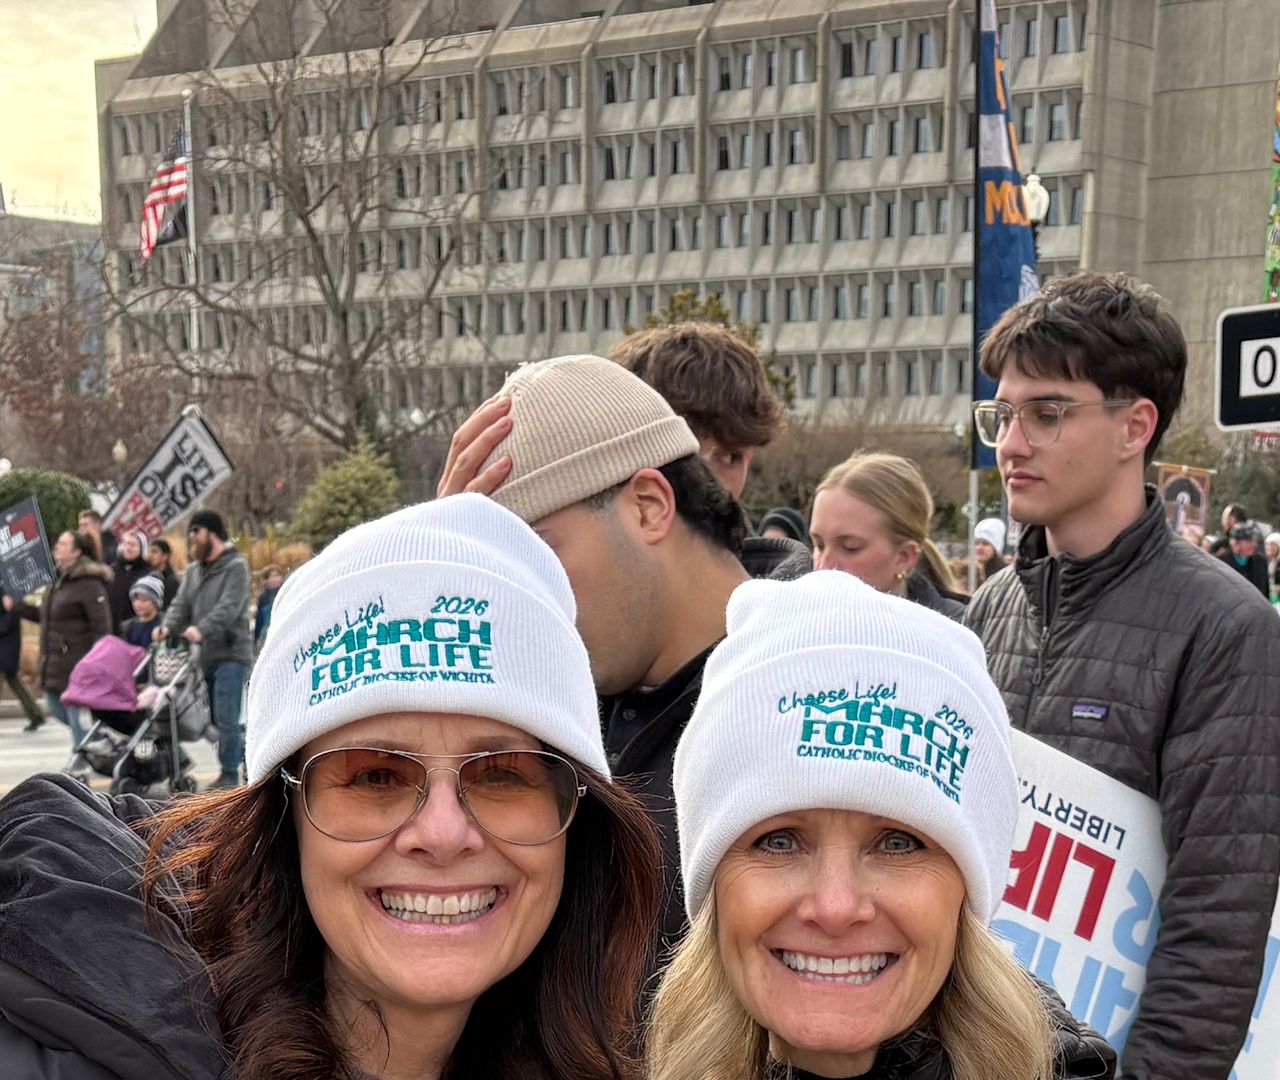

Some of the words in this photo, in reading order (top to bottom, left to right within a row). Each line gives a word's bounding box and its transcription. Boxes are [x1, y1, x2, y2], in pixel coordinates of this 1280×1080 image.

[155, 447, 198, 509] IS
[176, 432, 216, 487] LIFE
[138, 475, 179, 524] OUR
[430, 595, 489, 616] 2026
[293, 622, 342, 674] Choose
[344, 594, 385, 630] Life!
[312, 618, 492, 665] MARCH
[309, 675, 359, 707] CATHOLIC
[361, 671, 418, 687] DIOCESE
[420, 671, 437, 682] OF
[438, 671, 496, 685] WICHITA
[311, 648, 382, 691] FOR
[400, 643, 493, 670] LIFE
[778, 686, 850, 715] Choose
[854, 681, 898, 706] Life!
[804, 698, 970, 769] MARCH
[934, 704, 974, 741] 2026
[797, 744, 862, 761] CATHOLIC
[863, 750, 915, 774] DIOCESE
[915, 764, 930, 779] OF
[801, 719, 885, 749] FOR
[900, 733, 965, 792] LIFE
